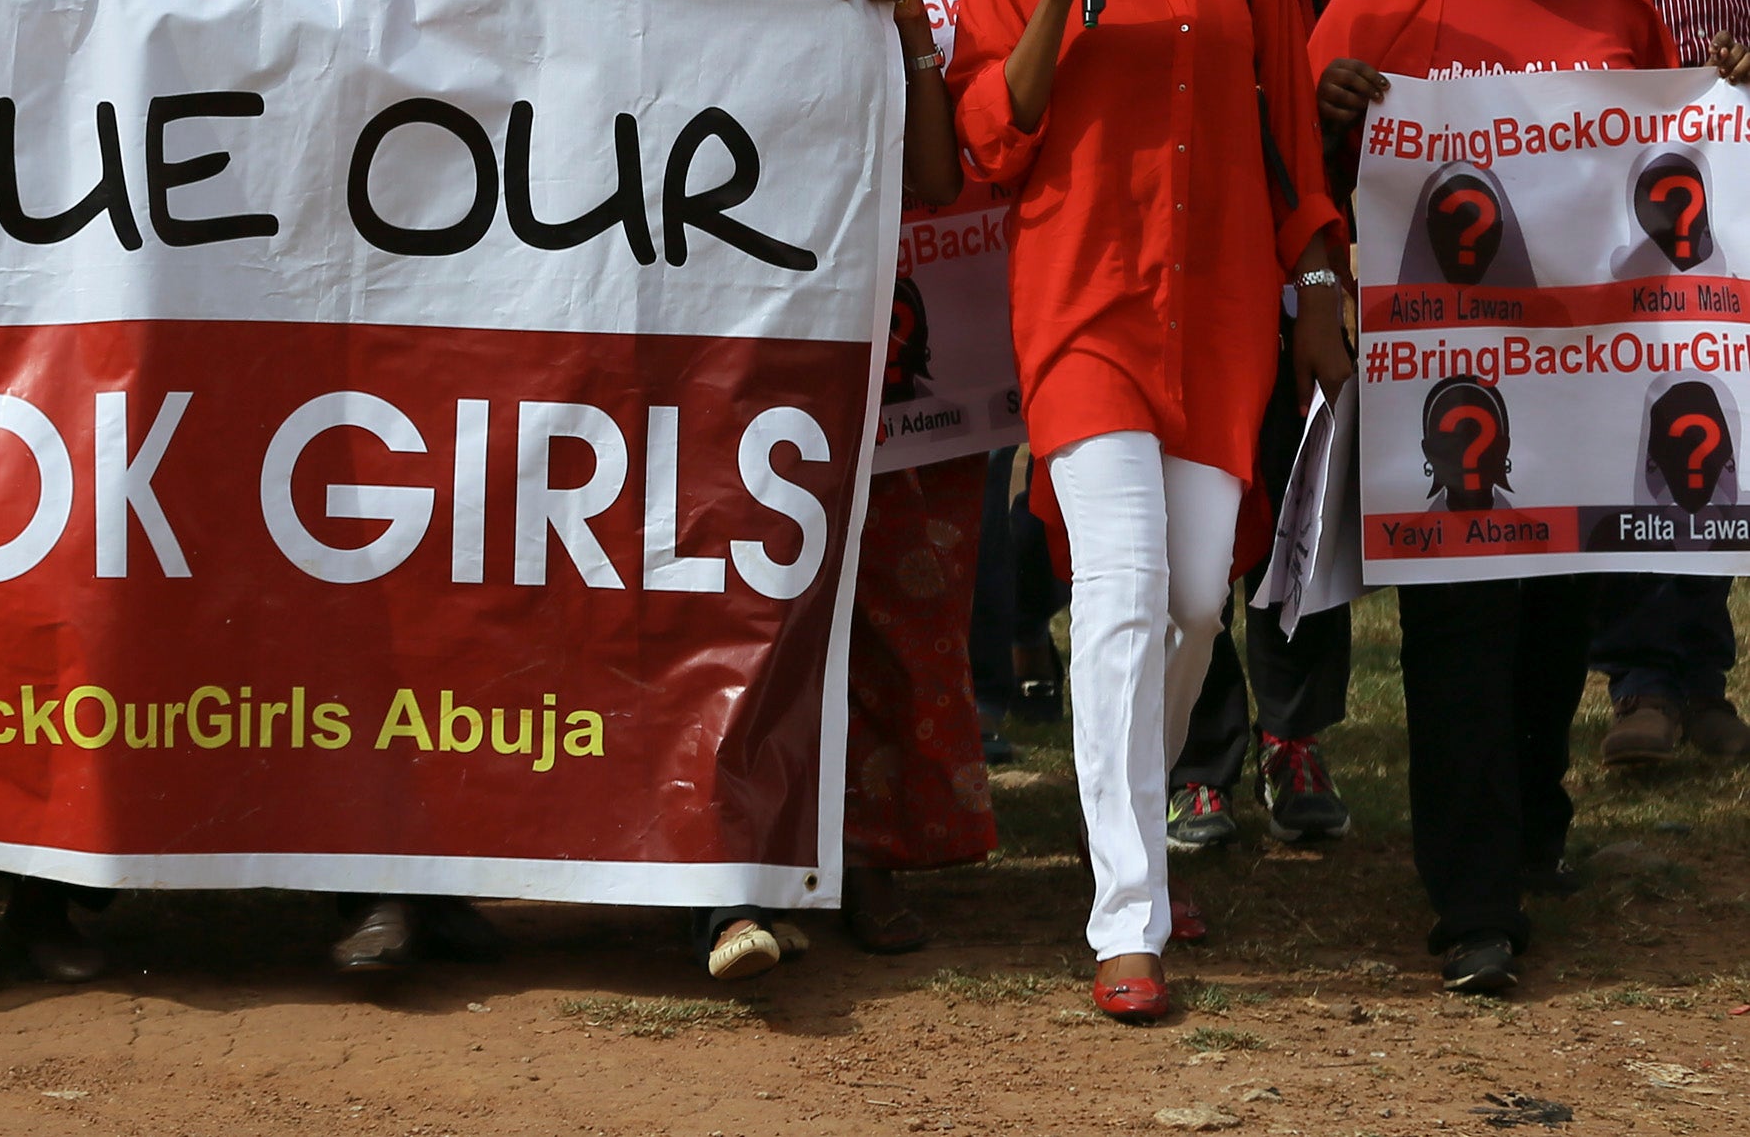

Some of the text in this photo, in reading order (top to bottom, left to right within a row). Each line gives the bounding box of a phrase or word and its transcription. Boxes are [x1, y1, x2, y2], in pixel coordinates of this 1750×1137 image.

[347, 95, 818, 272] OUR
[1390, 289, 1445, 323] Aisha
[1457, 287, 1523, 322] Lawan
[1633, 285, 1685, 313] Kabu
[901, 409, 962, 435] Adamu
[260, 390, 831, 600] GIRLS
[1382, 519, 1443, 547] Yayi
[1465, 517, 1550, 543] Abana
[375, 688, 605, 772] Abuja
